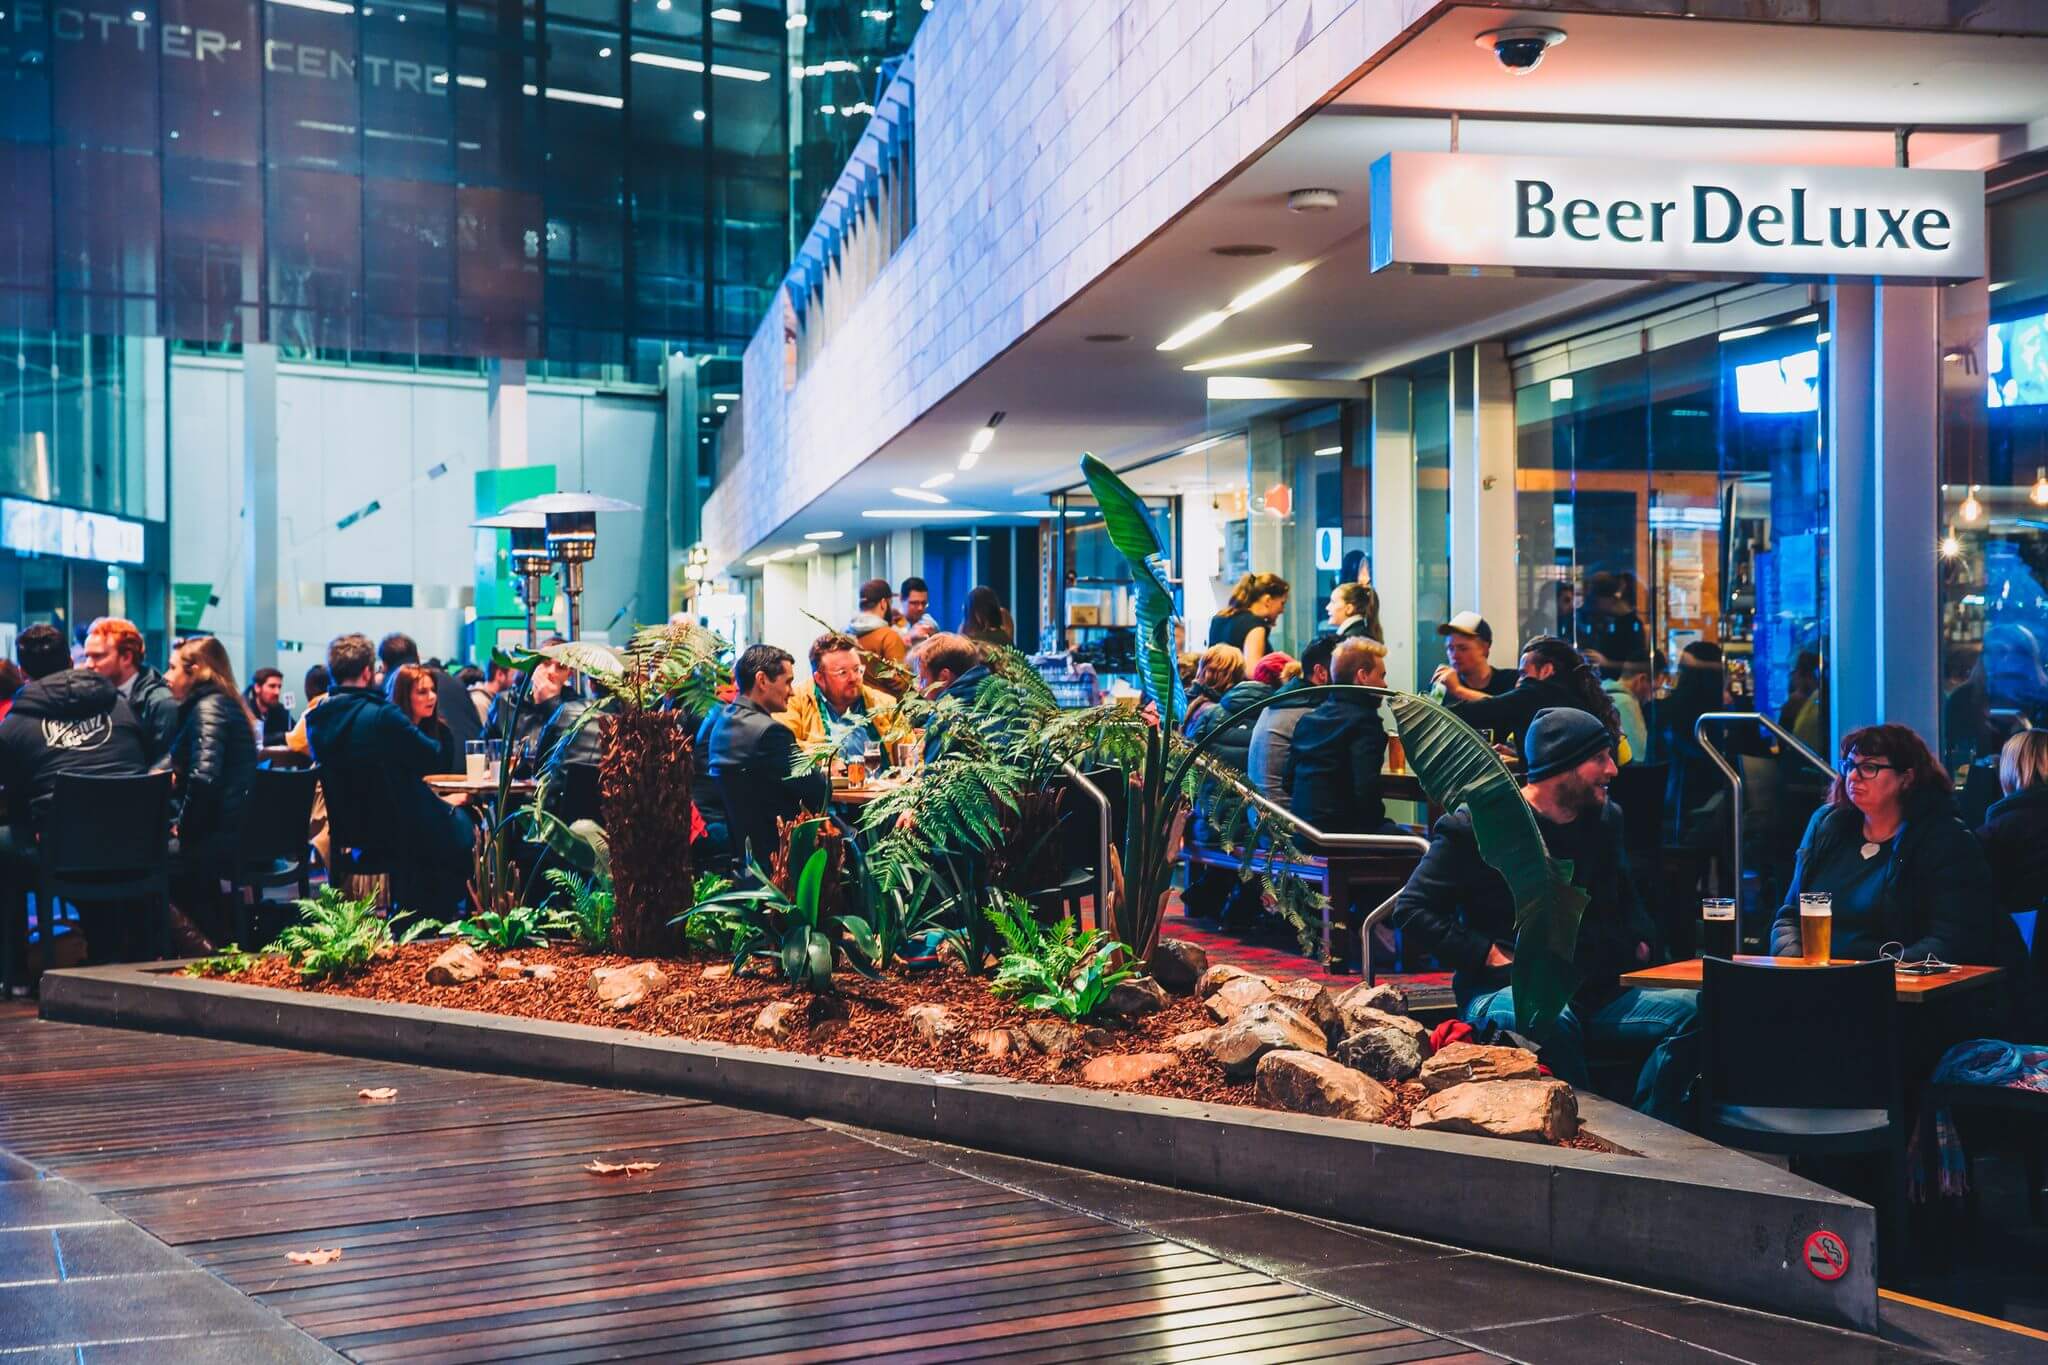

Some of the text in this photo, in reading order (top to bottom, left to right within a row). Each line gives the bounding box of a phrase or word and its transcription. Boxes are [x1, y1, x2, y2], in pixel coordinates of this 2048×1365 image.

[264, 38, 449, 96] CENTRE
[1514, 179, 1951, 250] Beer DeLuxe
